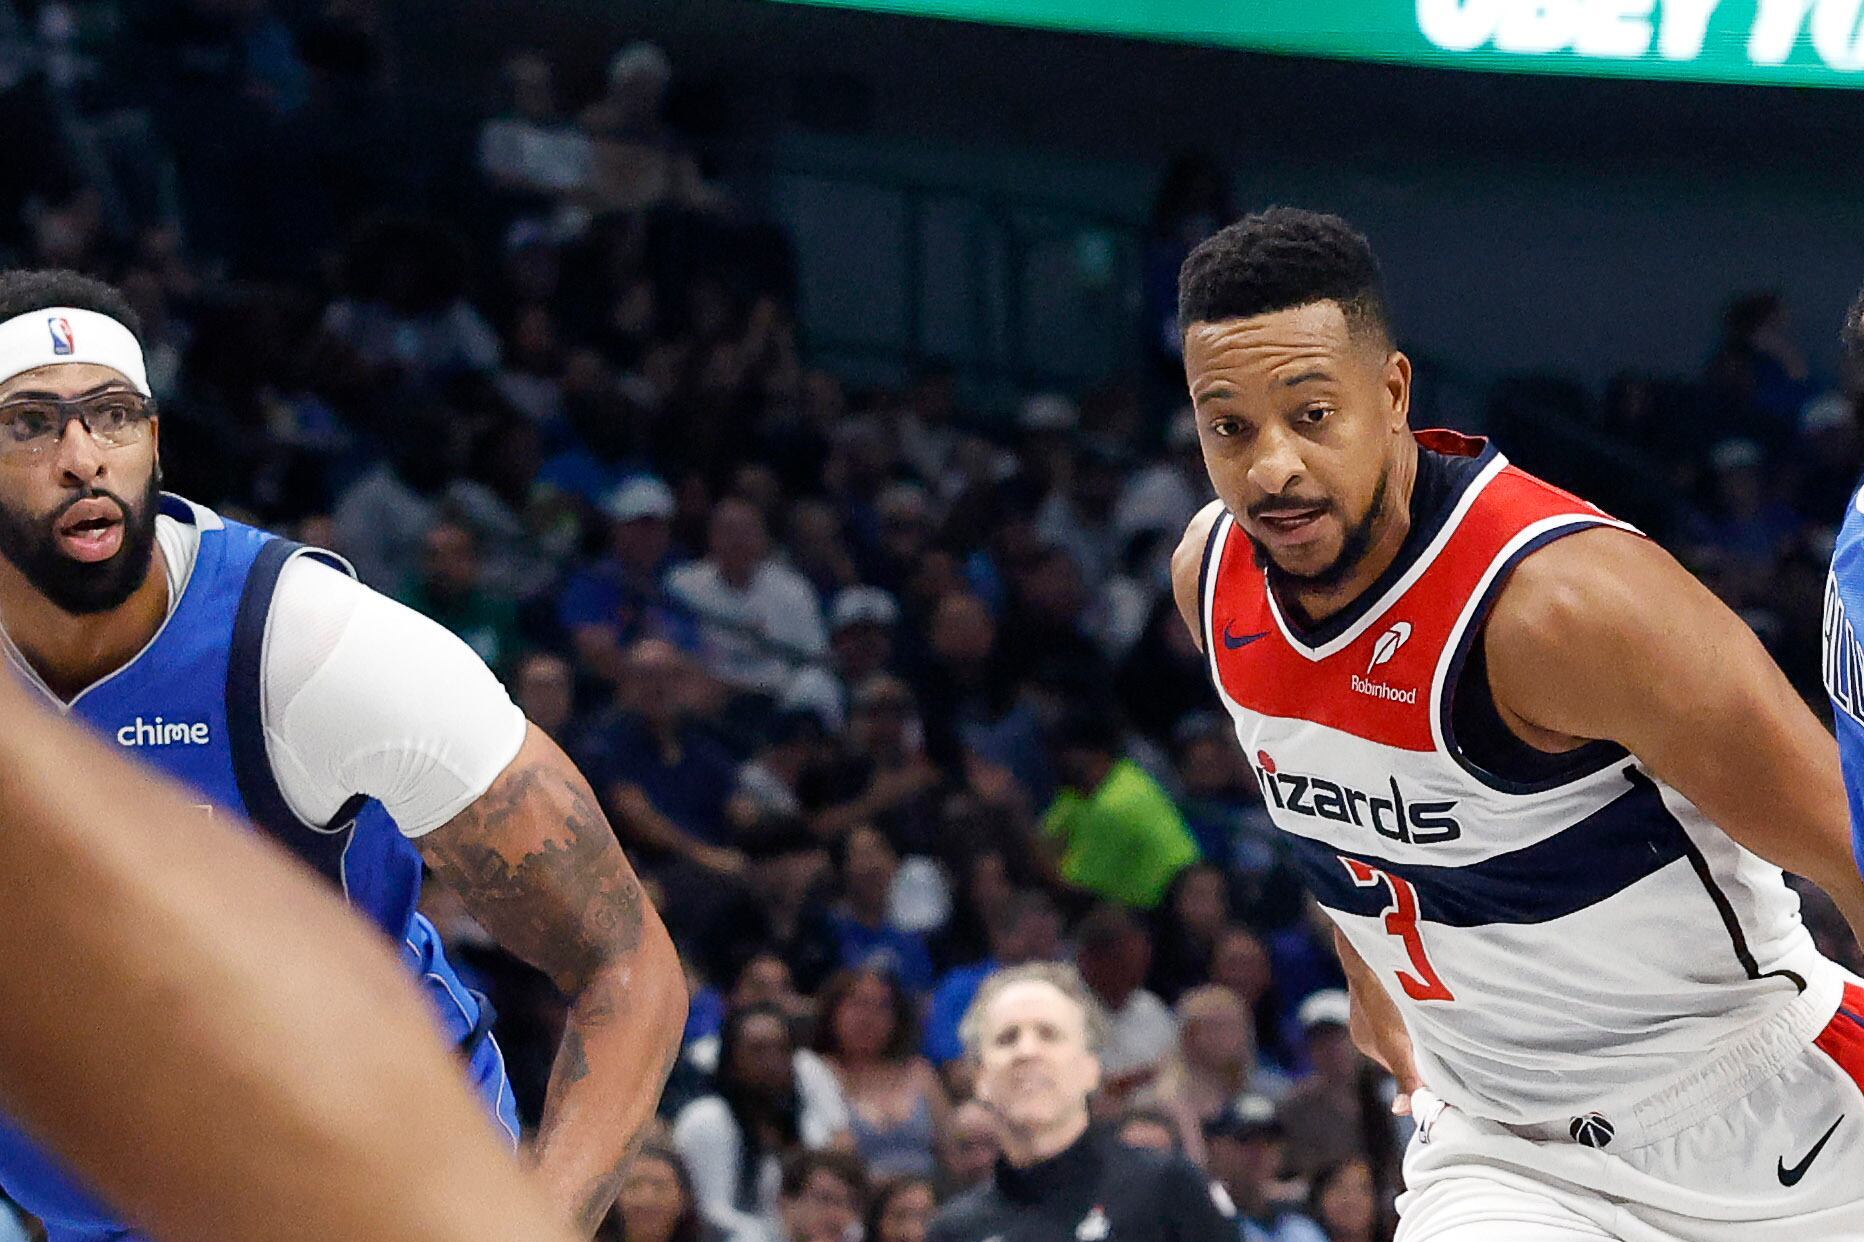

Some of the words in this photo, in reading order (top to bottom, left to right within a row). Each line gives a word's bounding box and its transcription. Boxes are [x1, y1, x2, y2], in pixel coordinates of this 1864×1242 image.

[1351, 674, 1416, 704] Robinhood
[117, 716, 209, 746] chime
[1256, 749, 1461, 844] izards
[1336, 854, 1455, 1001] 3
